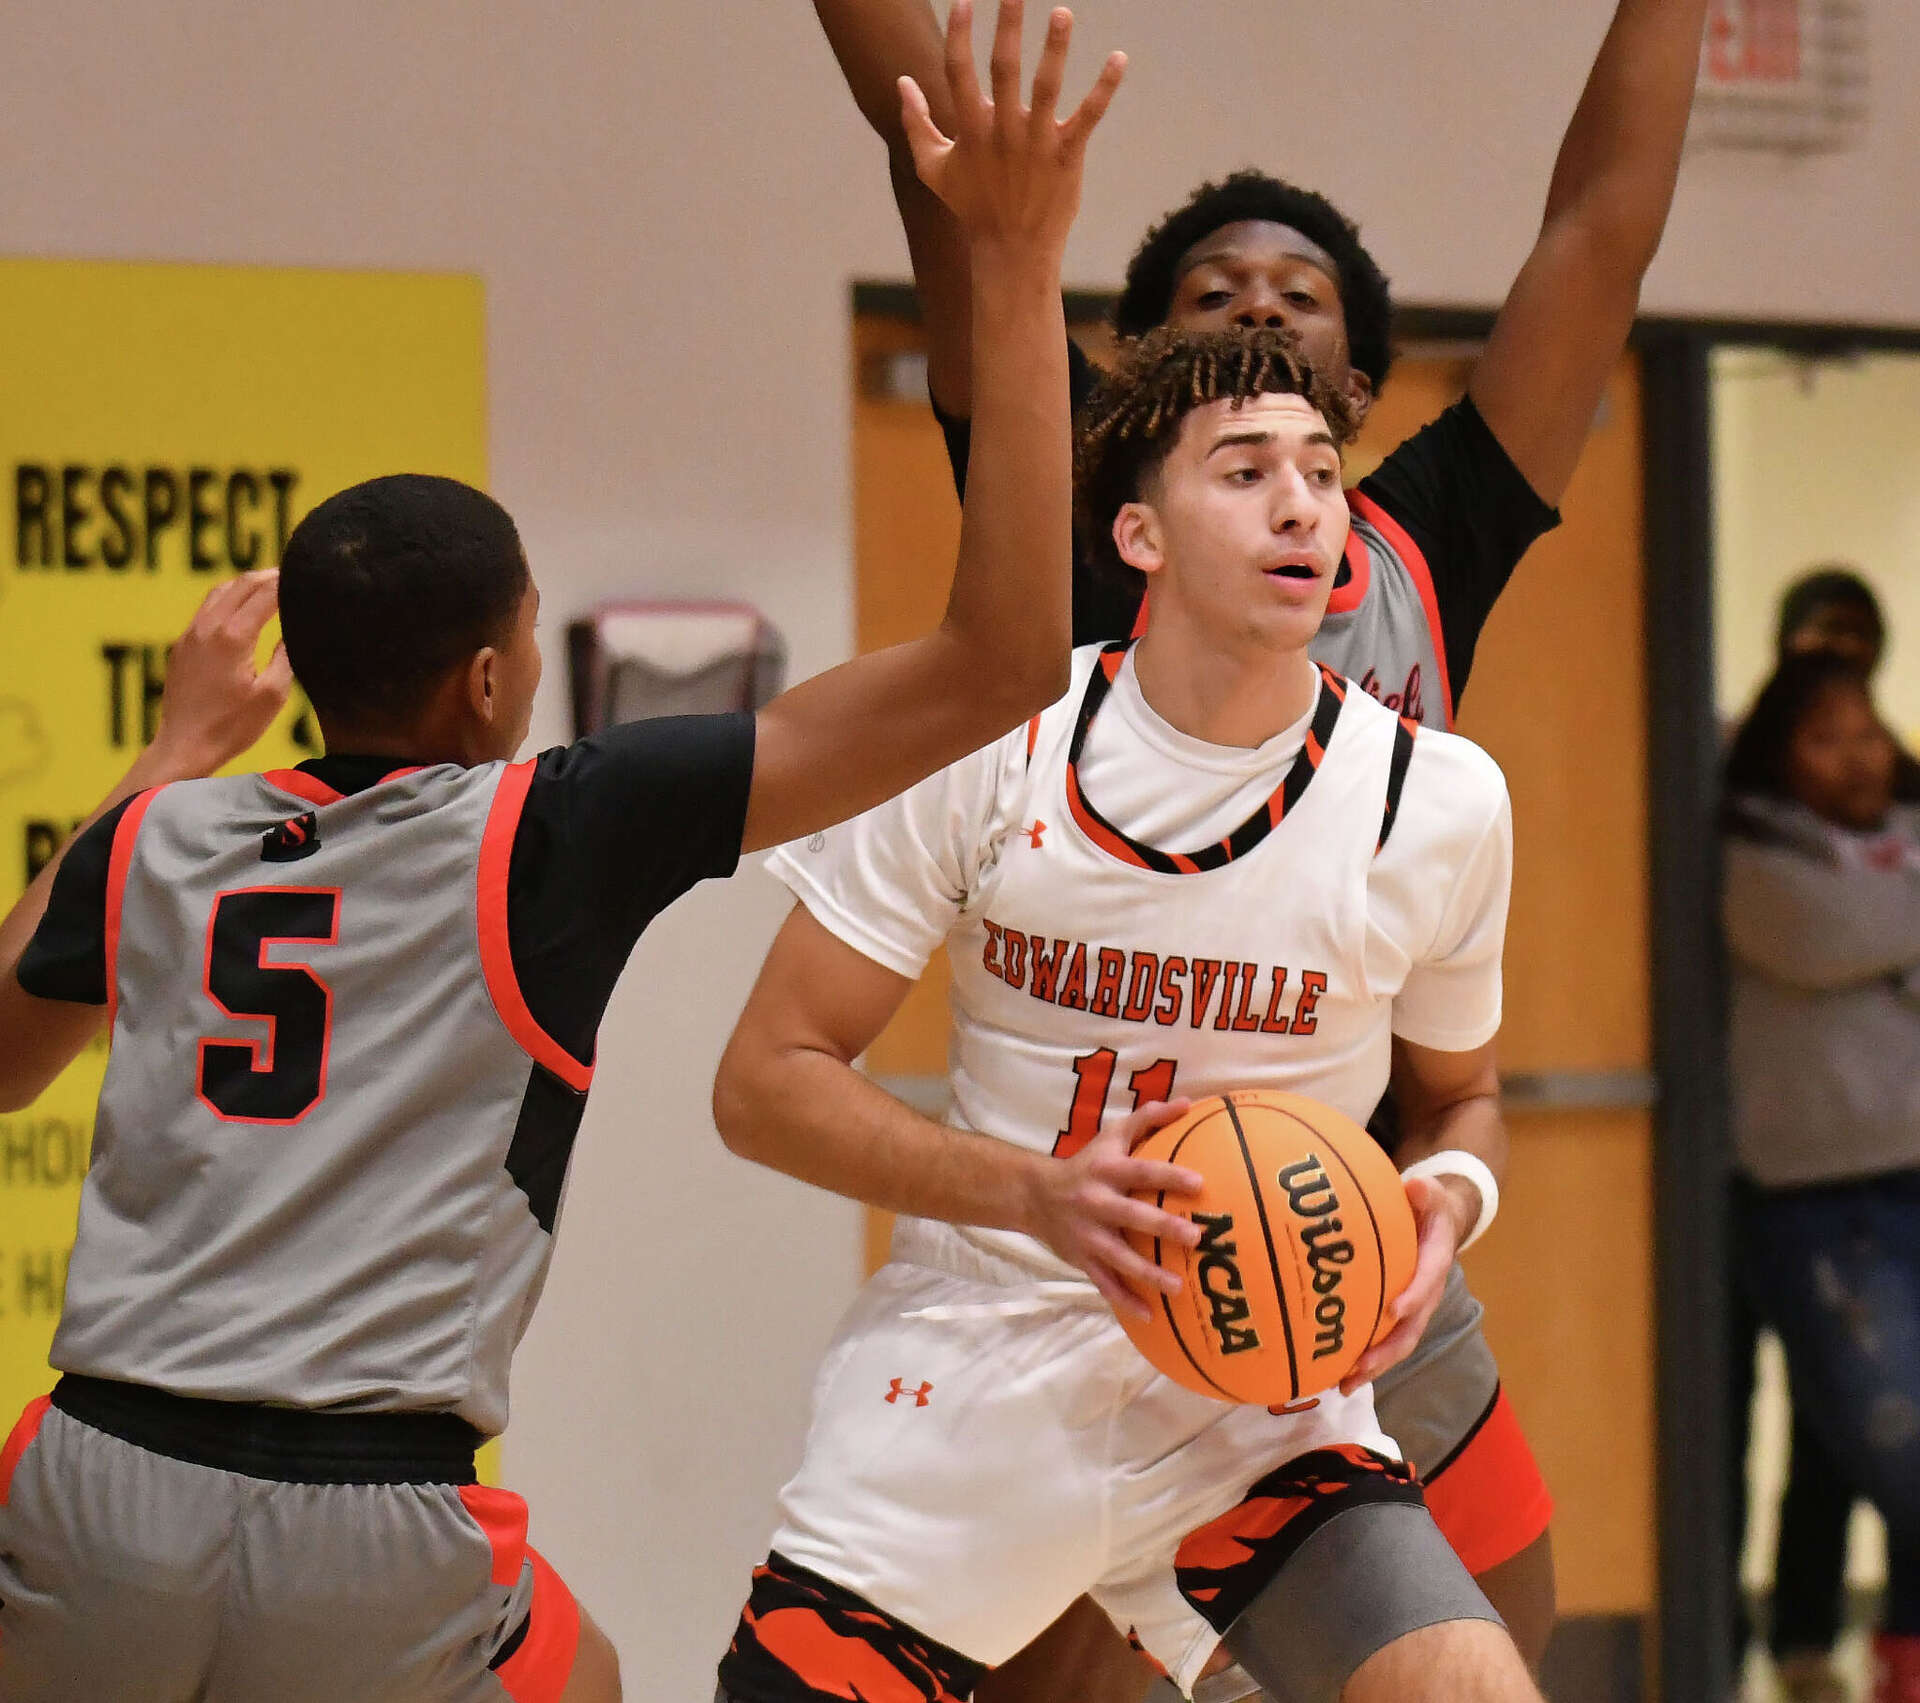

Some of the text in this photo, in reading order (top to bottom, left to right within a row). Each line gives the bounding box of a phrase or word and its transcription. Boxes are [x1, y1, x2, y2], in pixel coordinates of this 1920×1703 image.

[14, 463, 299, 572] RESPECT
[195, 885, 343, 1126] 5
[983, 918, 1328, 1036] EDWARDSVILLE
[1191, 1212, 1263, 1356] NCAA
[1277, 1153, 1355, 1361] Wilson
